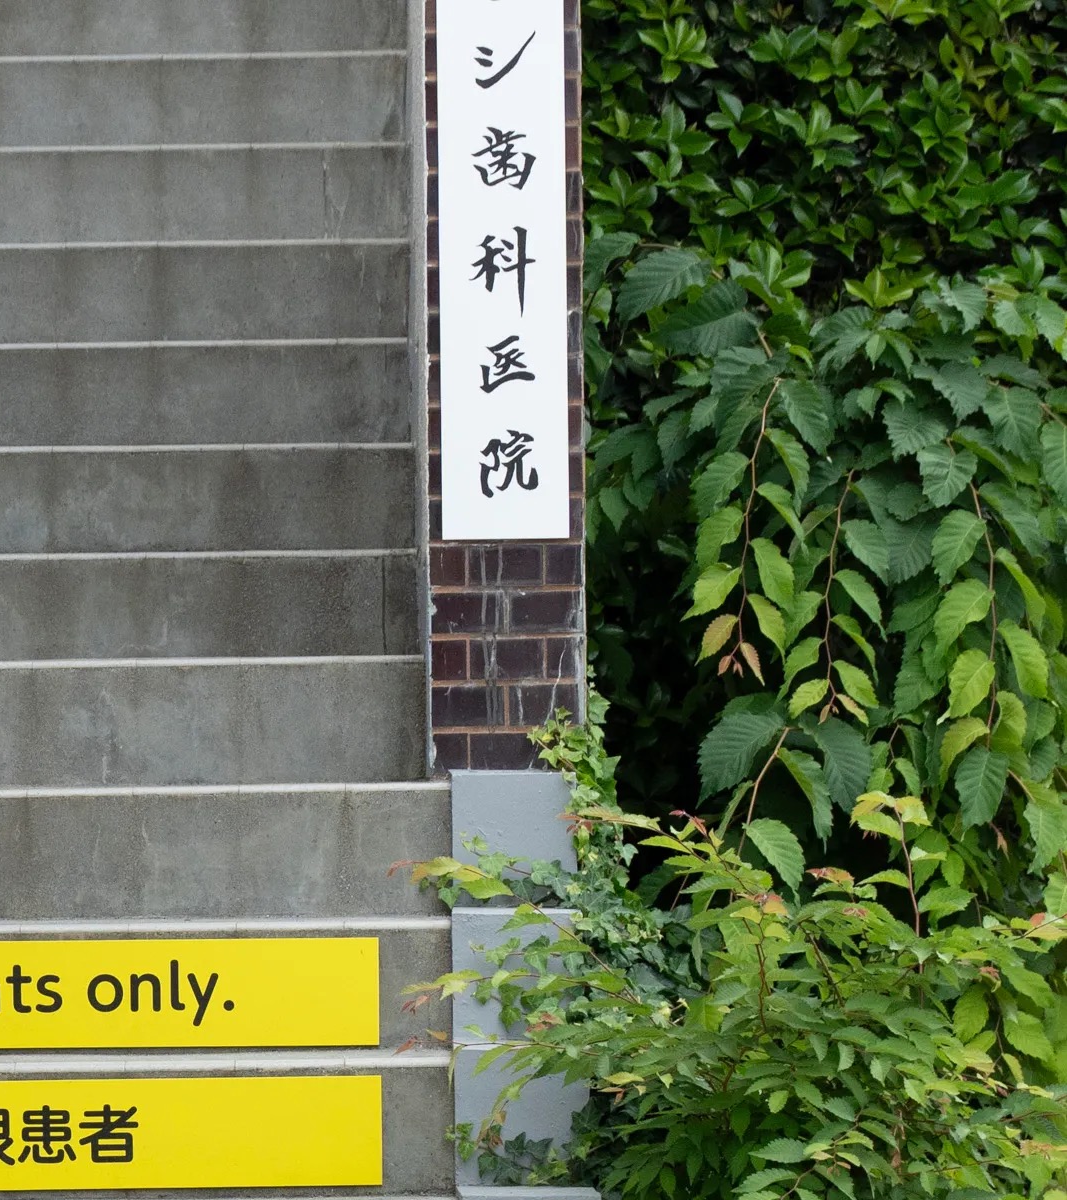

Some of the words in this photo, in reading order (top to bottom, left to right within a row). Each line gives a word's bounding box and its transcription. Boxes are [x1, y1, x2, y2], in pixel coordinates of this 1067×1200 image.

[469, 30, 539, 498] シ歯科医院
[86, 959, 235, 1027] only.
